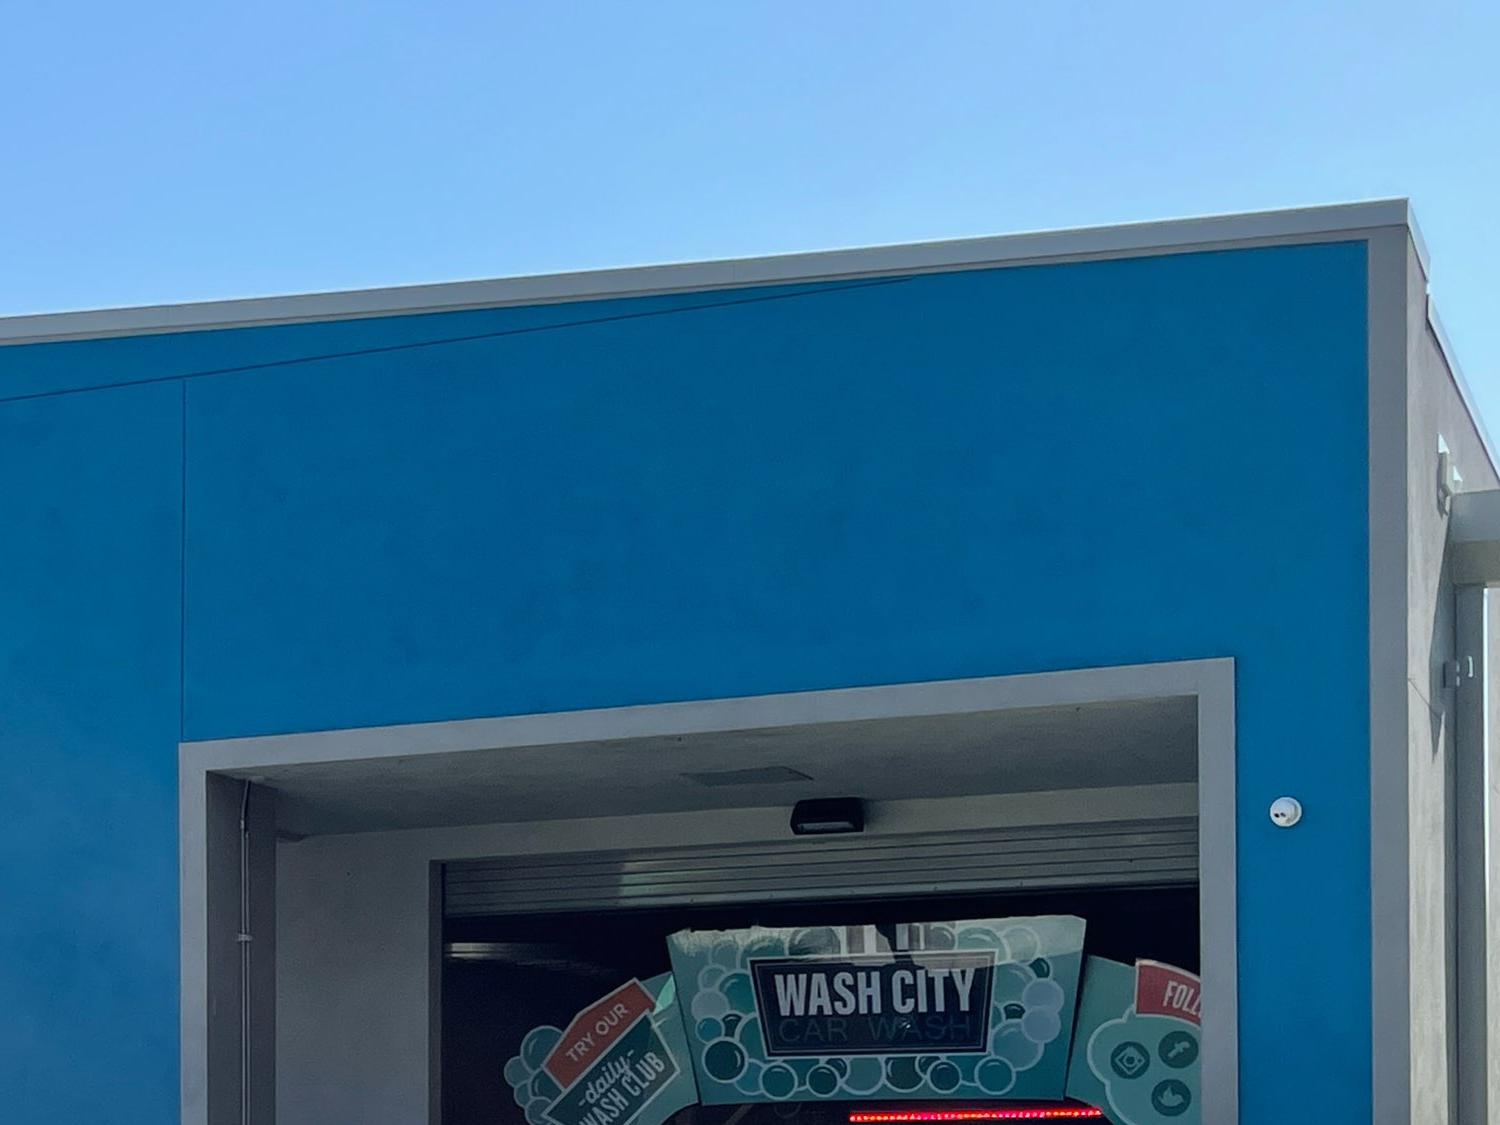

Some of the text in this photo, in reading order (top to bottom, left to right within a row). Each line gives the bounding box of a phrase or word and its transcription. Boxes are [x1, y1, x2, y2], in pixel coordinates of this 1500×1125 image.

[774, 966, 976, 1017] WASH CITY
[1162, 980, 1201, 1018] FOLL
[565, 1003, 629, 1062] TRY OUR
[778, 1014, 971, 1042] CAR WASH
[621, 1052, 665, 1096] CLUB
